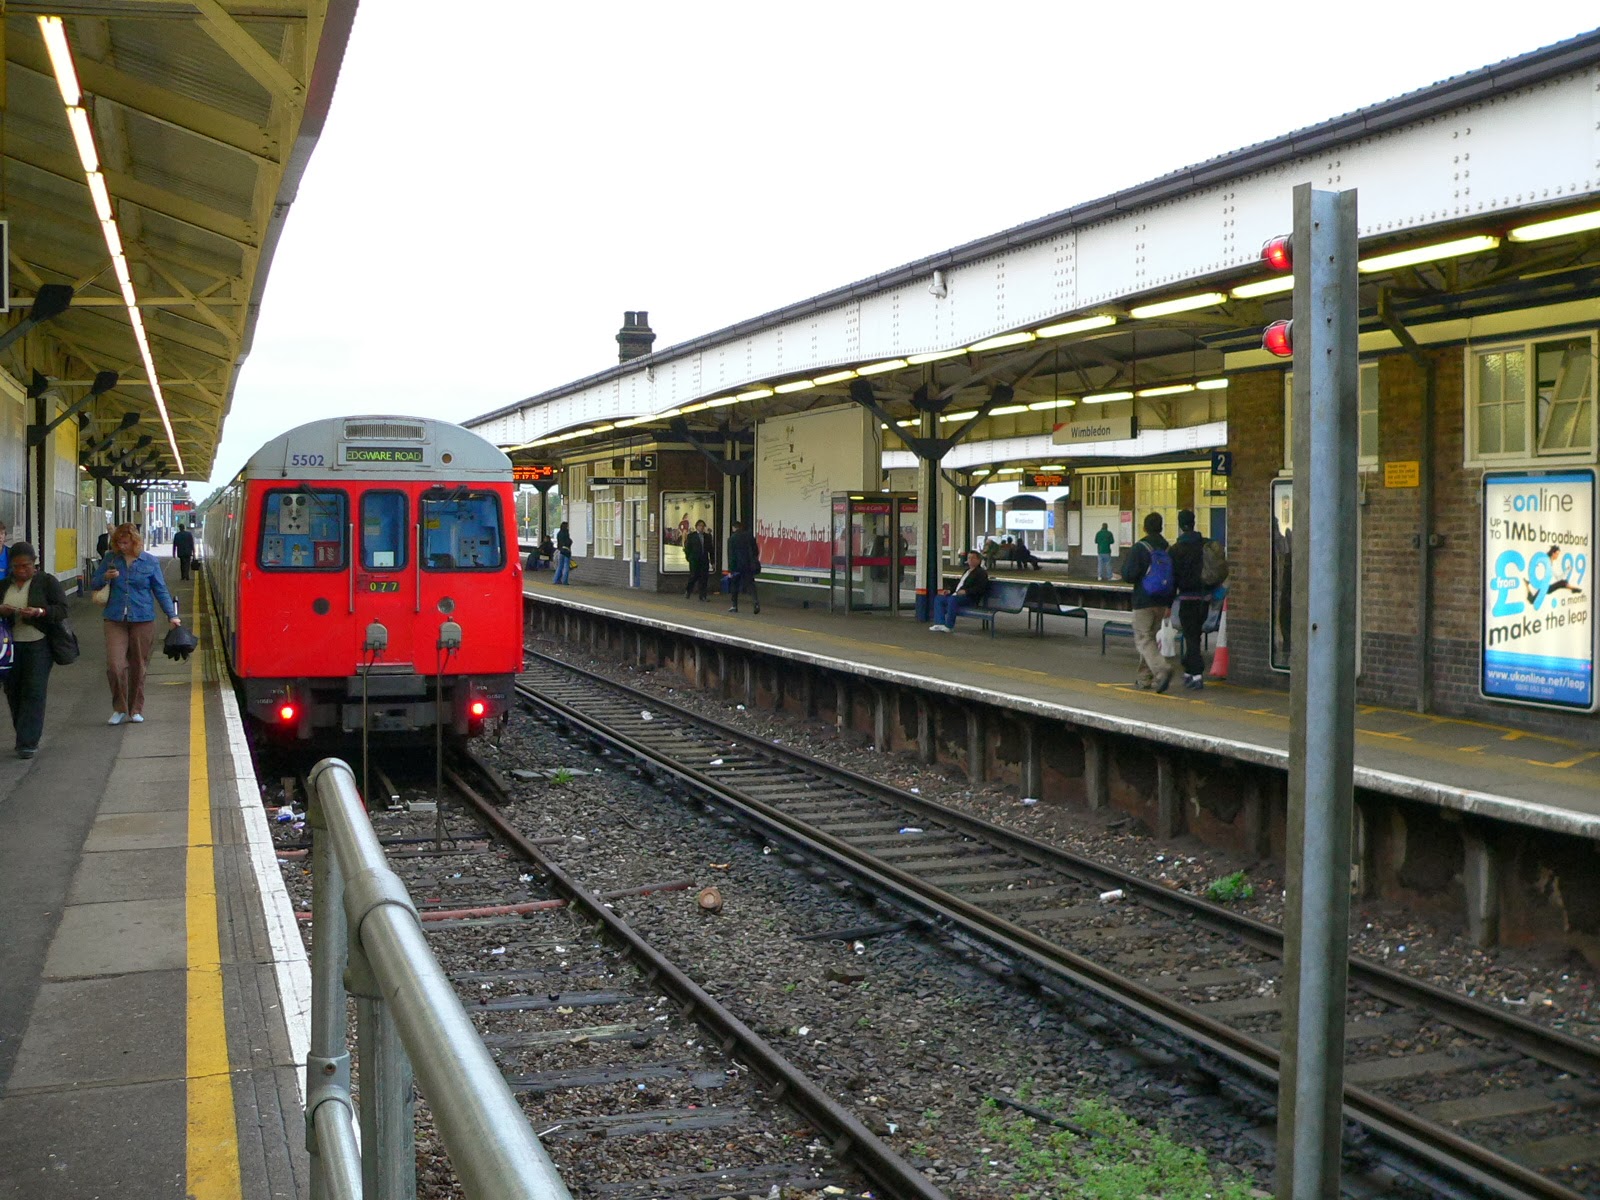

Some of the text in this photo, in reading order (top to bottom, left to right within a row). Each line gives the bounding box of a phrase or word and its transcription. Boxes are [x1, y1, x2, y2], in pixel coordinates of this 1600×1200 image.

[1071, 424, 1111, 438] Wimbledon
[291, 454, 325, 467] 5502
[347, 451, 421, 461] EDGWARE ROAD
[644, 456, 653, 468] 5
[1217, 454, 1226, 471] 2
[1513, 487, 1574, 512] online
[1490, 517, 1501, 527] UP
[810, 523, 826, 543] that
[1490, 529, 1501, 540] TO
[1503, 520, 1588, 546] 1Mb broadband
[370, 582, 397, 592] 077
[1496, 577, 1517, 589] from
[1561, 594, 1587, 606] a month
[1489, 609, 1588, 646] make the leap
[1487, 670, 1586, 692] www.ukonline.net/leap
